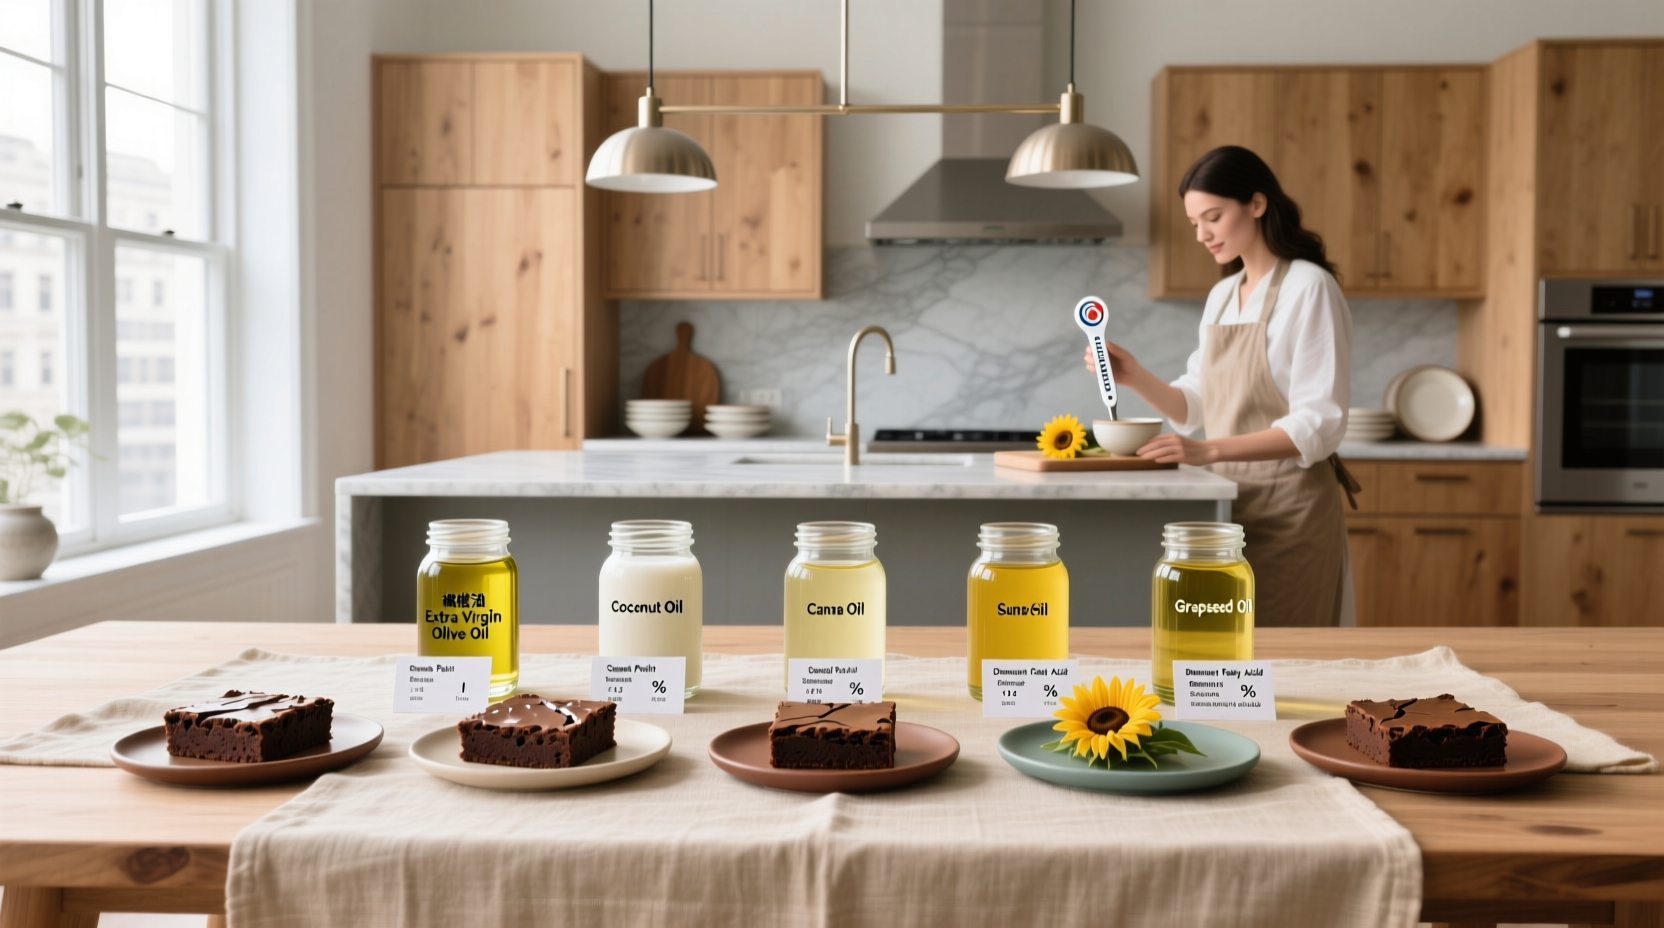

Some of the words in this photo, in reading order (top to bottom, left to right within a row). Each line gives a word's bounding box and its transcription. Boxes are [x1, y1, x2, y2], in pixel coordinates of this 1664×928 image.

[664, 600, 683, 613] Oil
[846, 601, 865, 616] Oil
[425, 609, 458, 624] Extra
[462, 609, 502, 627] Virgin
[470, 626, 489, 640] Oil
[651, 679, 667, 694] %
[849, 681, 864, 696] %
[1043, 684, 1058, 698] %
[1240, 684, 1257, 698] %
